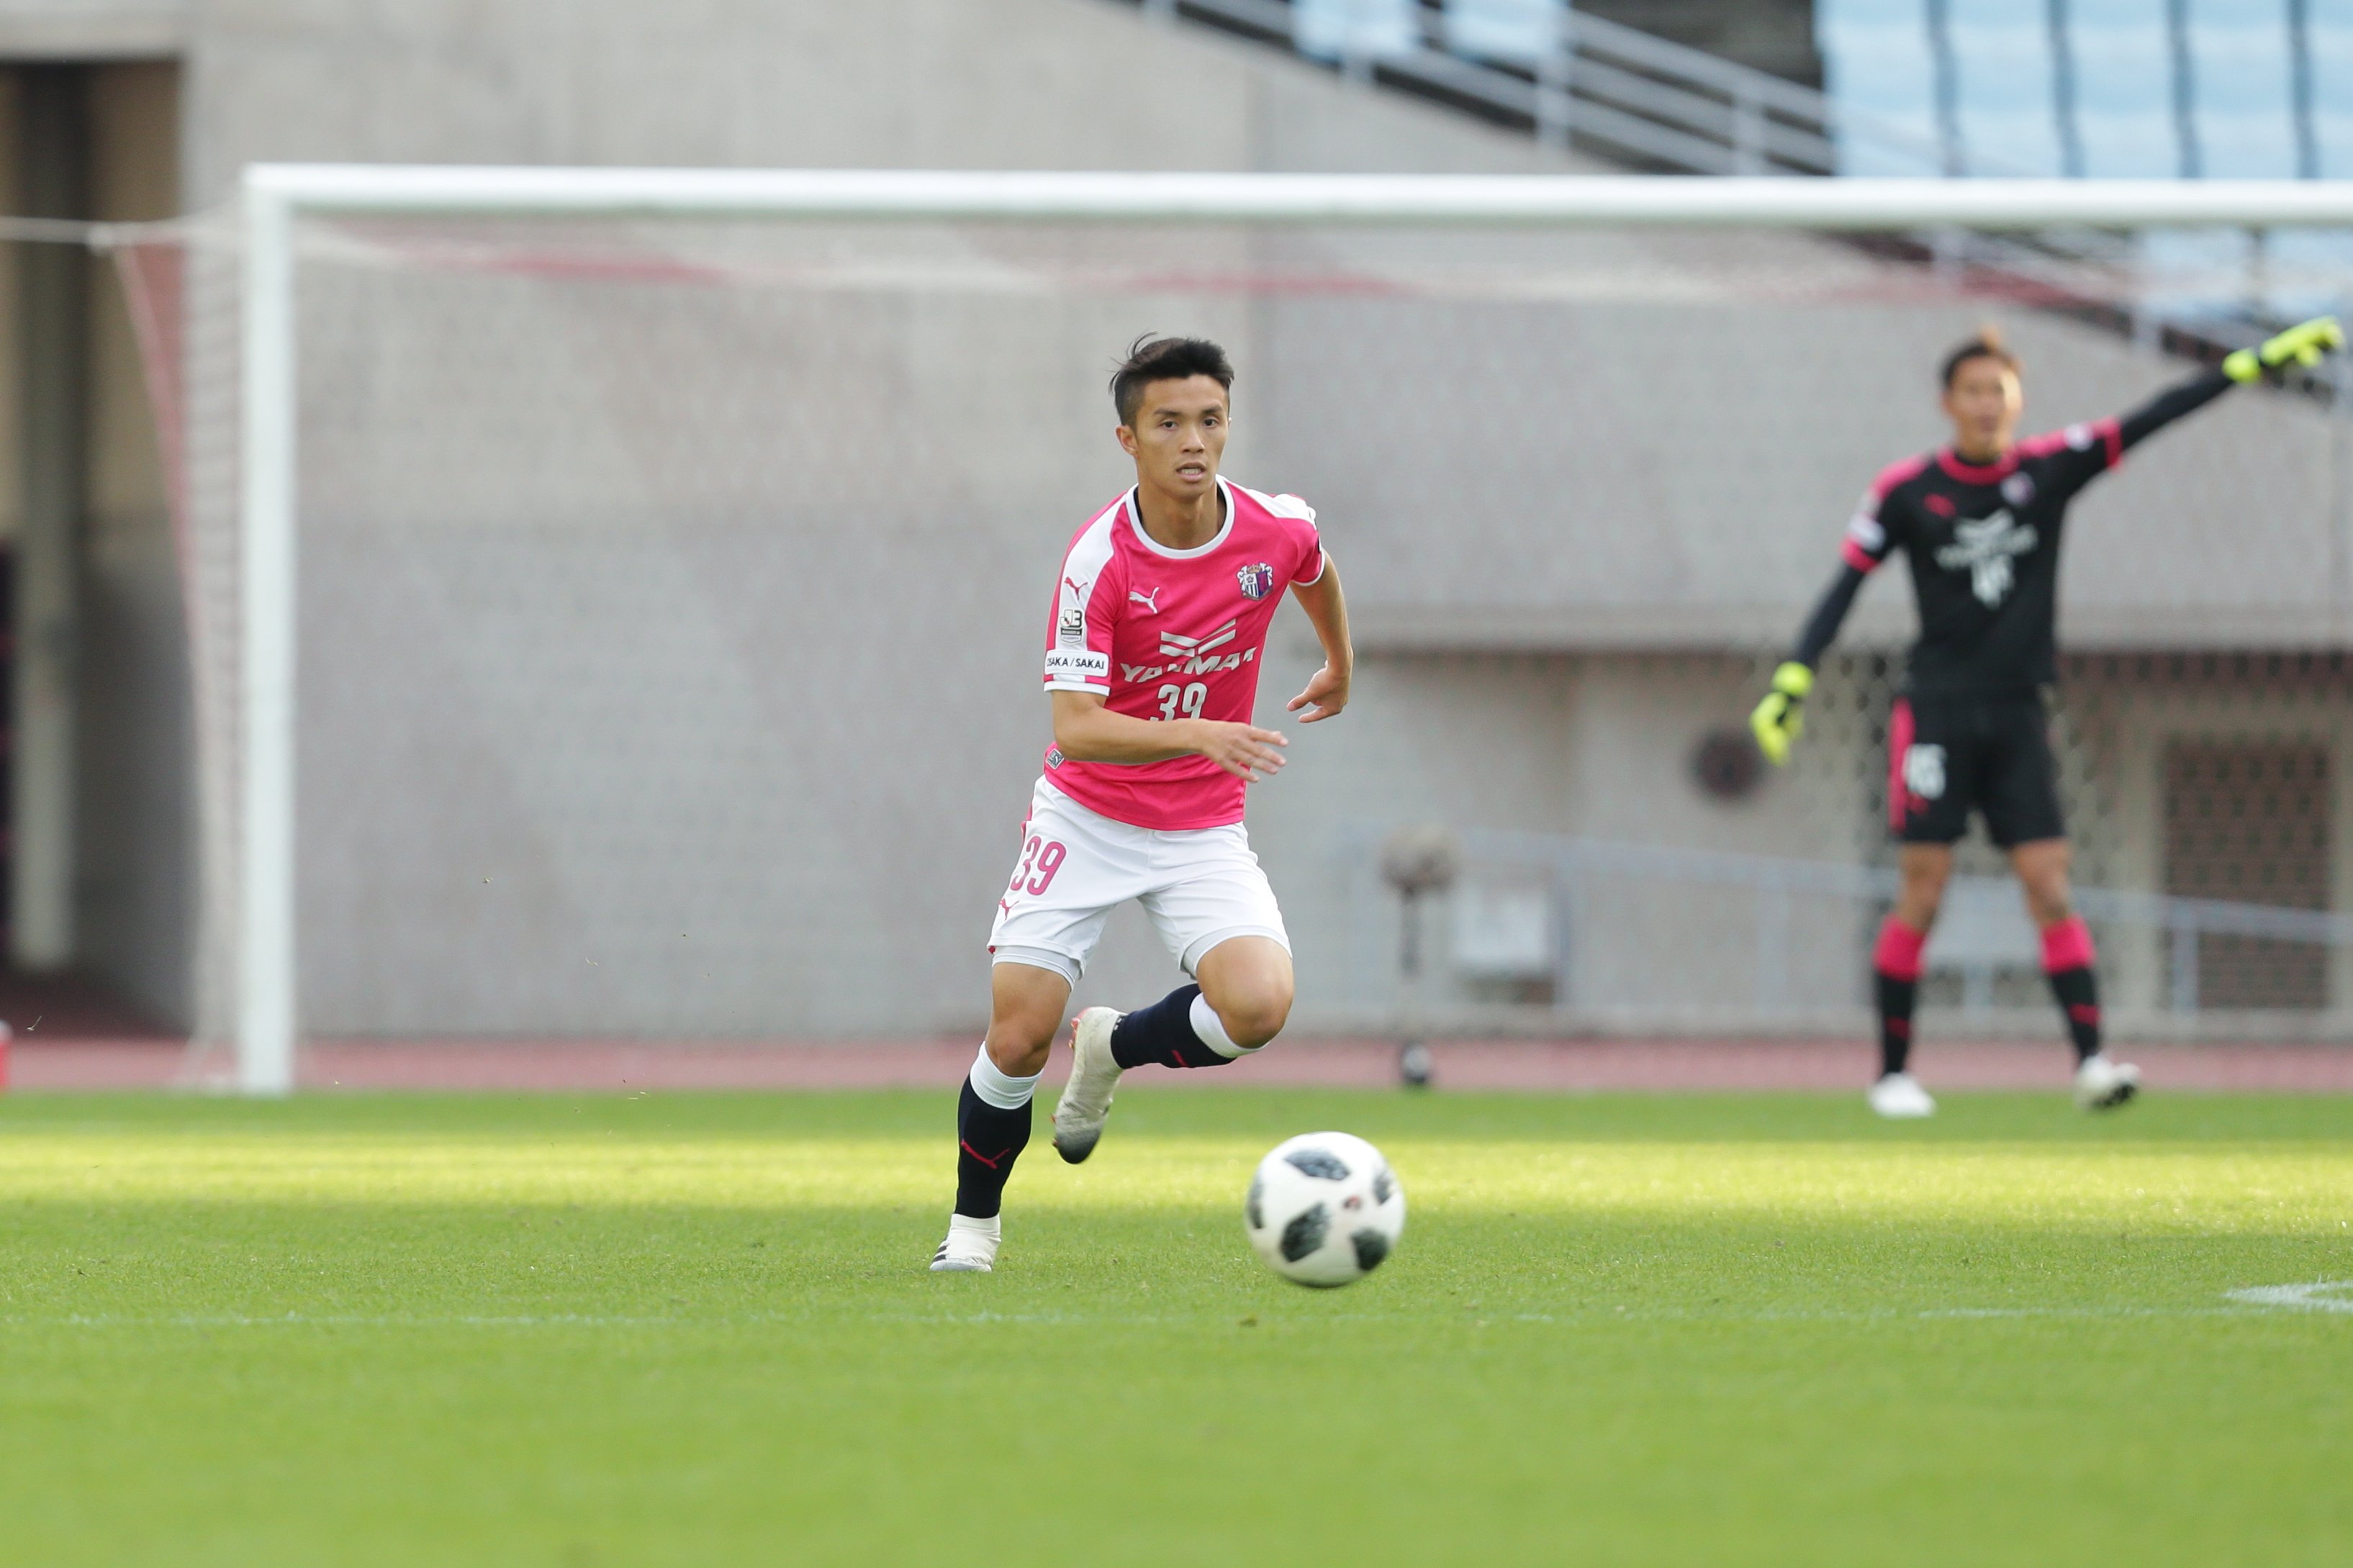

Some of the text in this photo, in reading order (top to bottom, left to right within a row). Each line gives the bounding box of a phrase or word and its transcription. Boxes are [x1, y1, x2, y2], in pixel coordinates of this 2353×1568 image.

[1075, 658, 1104, 669] SAKAI
[1150, 681, 1208, 721] 39
[1010, 835, 1067, 896] 39
